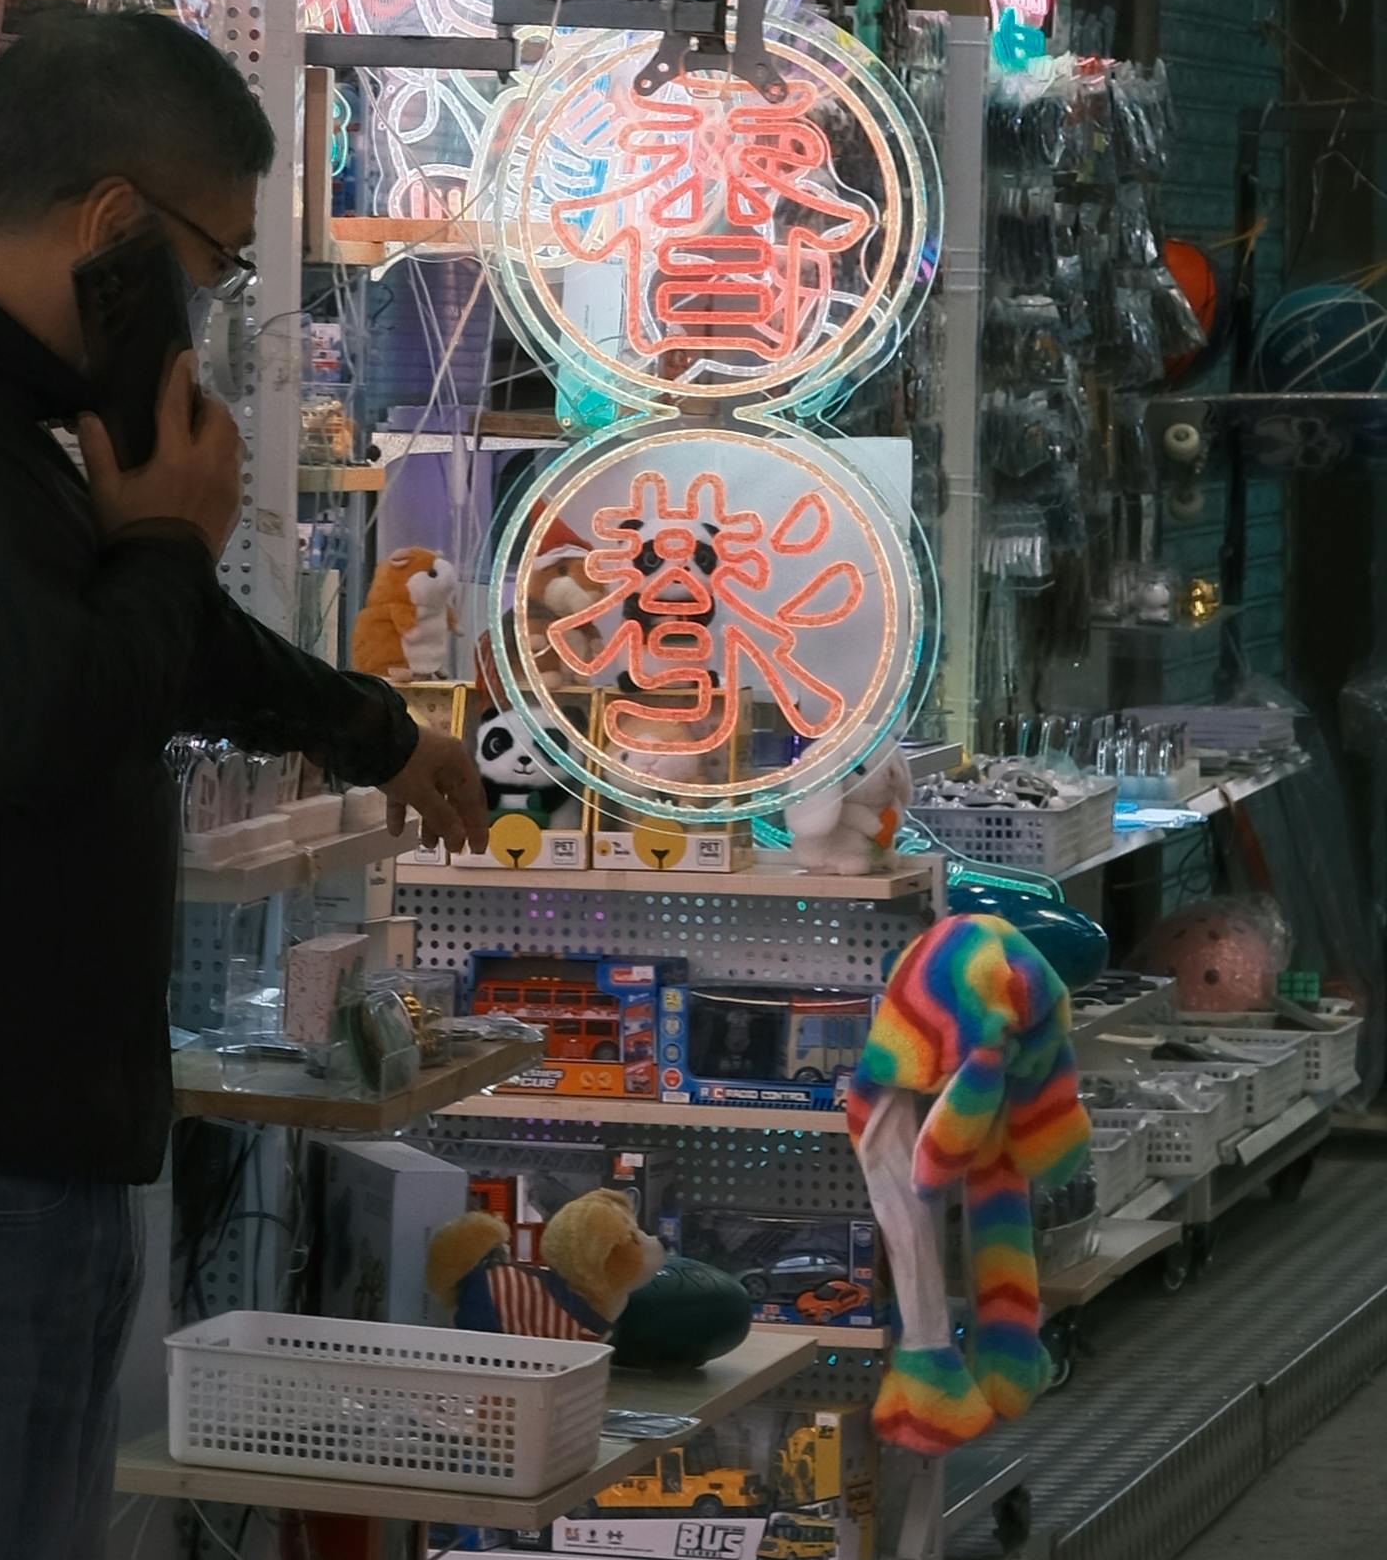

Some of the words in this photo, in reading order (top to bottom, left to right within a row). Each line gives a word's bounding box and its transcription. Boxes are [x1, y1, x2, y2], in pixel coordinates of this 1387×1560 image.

[554, 840, 576, 853] PET
[699, 840, 721, 853] PET
[760, 1088, 812, 1103] CONTROL
[676, 1521, 745, 1559] BUS
